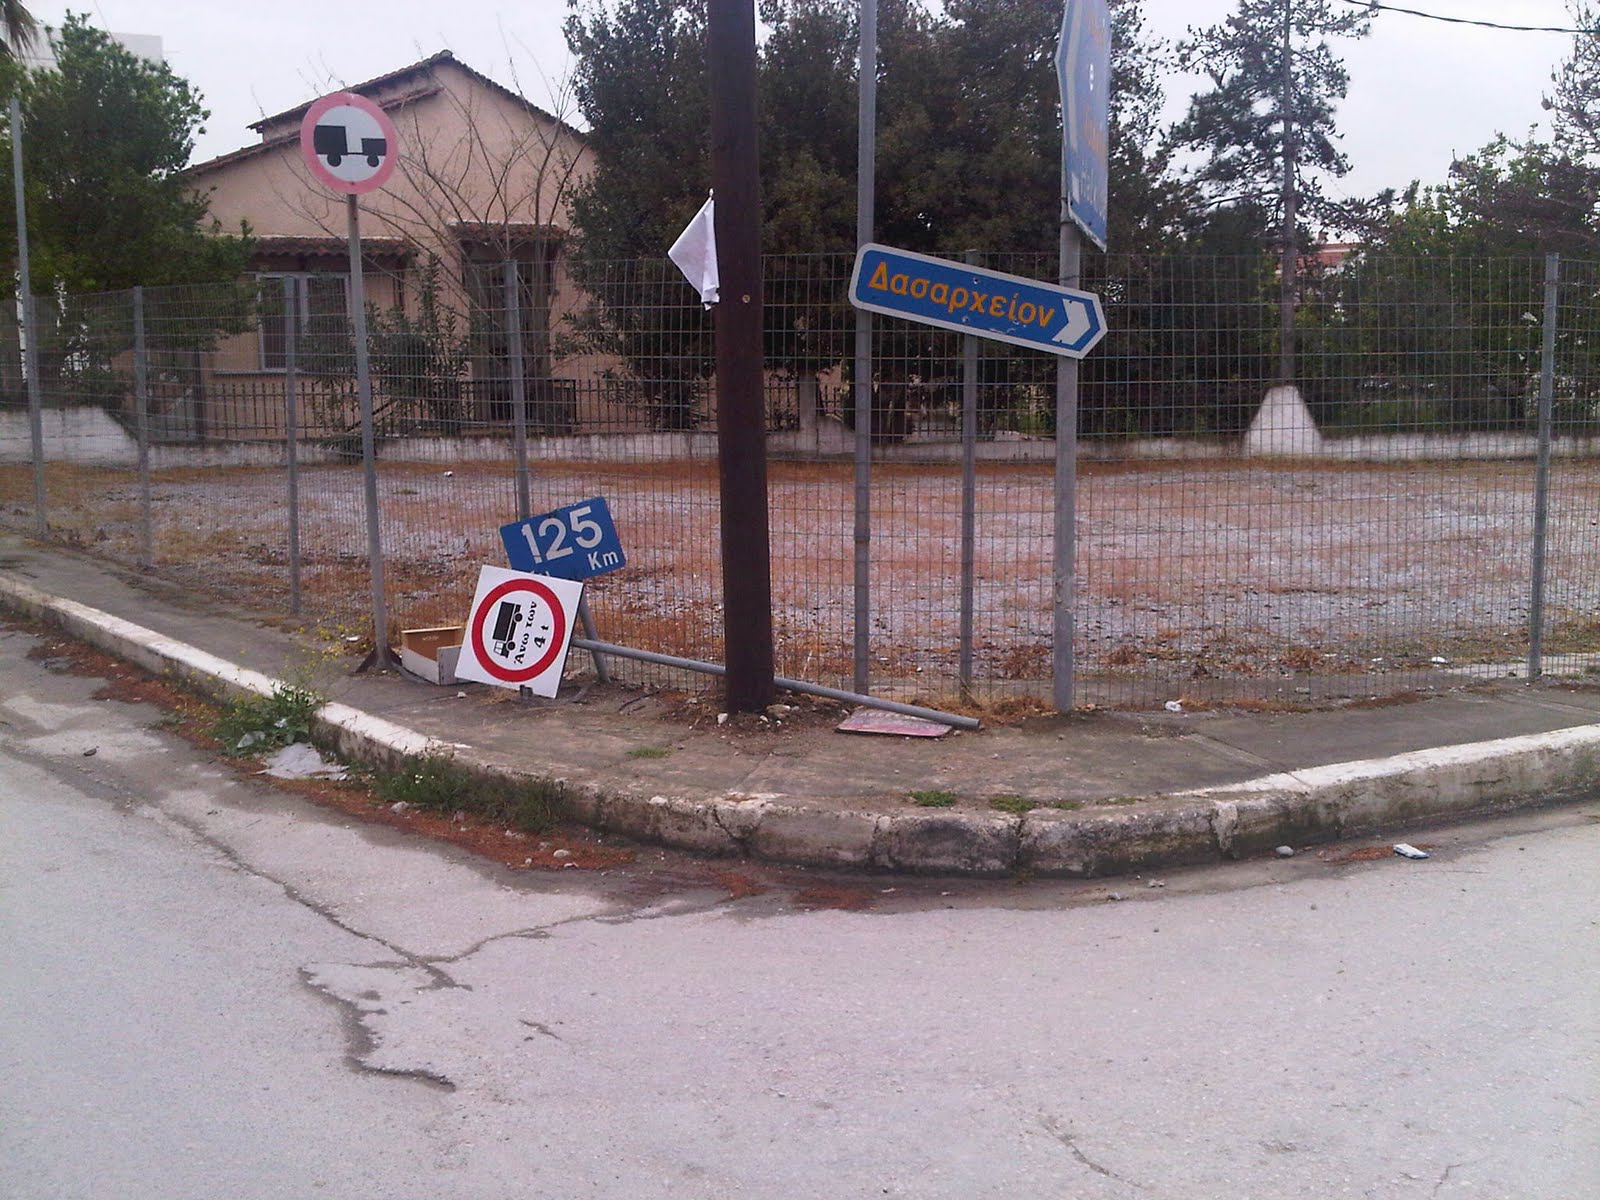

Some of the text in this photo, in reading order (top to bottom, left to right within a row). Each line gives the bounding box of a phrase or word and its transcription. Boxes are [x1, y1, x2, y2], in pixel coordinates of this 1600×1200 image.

[868, 261, 1055, 328] Δασαρχείον
[521, 505, 603, 564] 125
[588, 551, 619, 571] Km
[525, 601, 538, 628] των
[533, 636, 547, 648] 4
